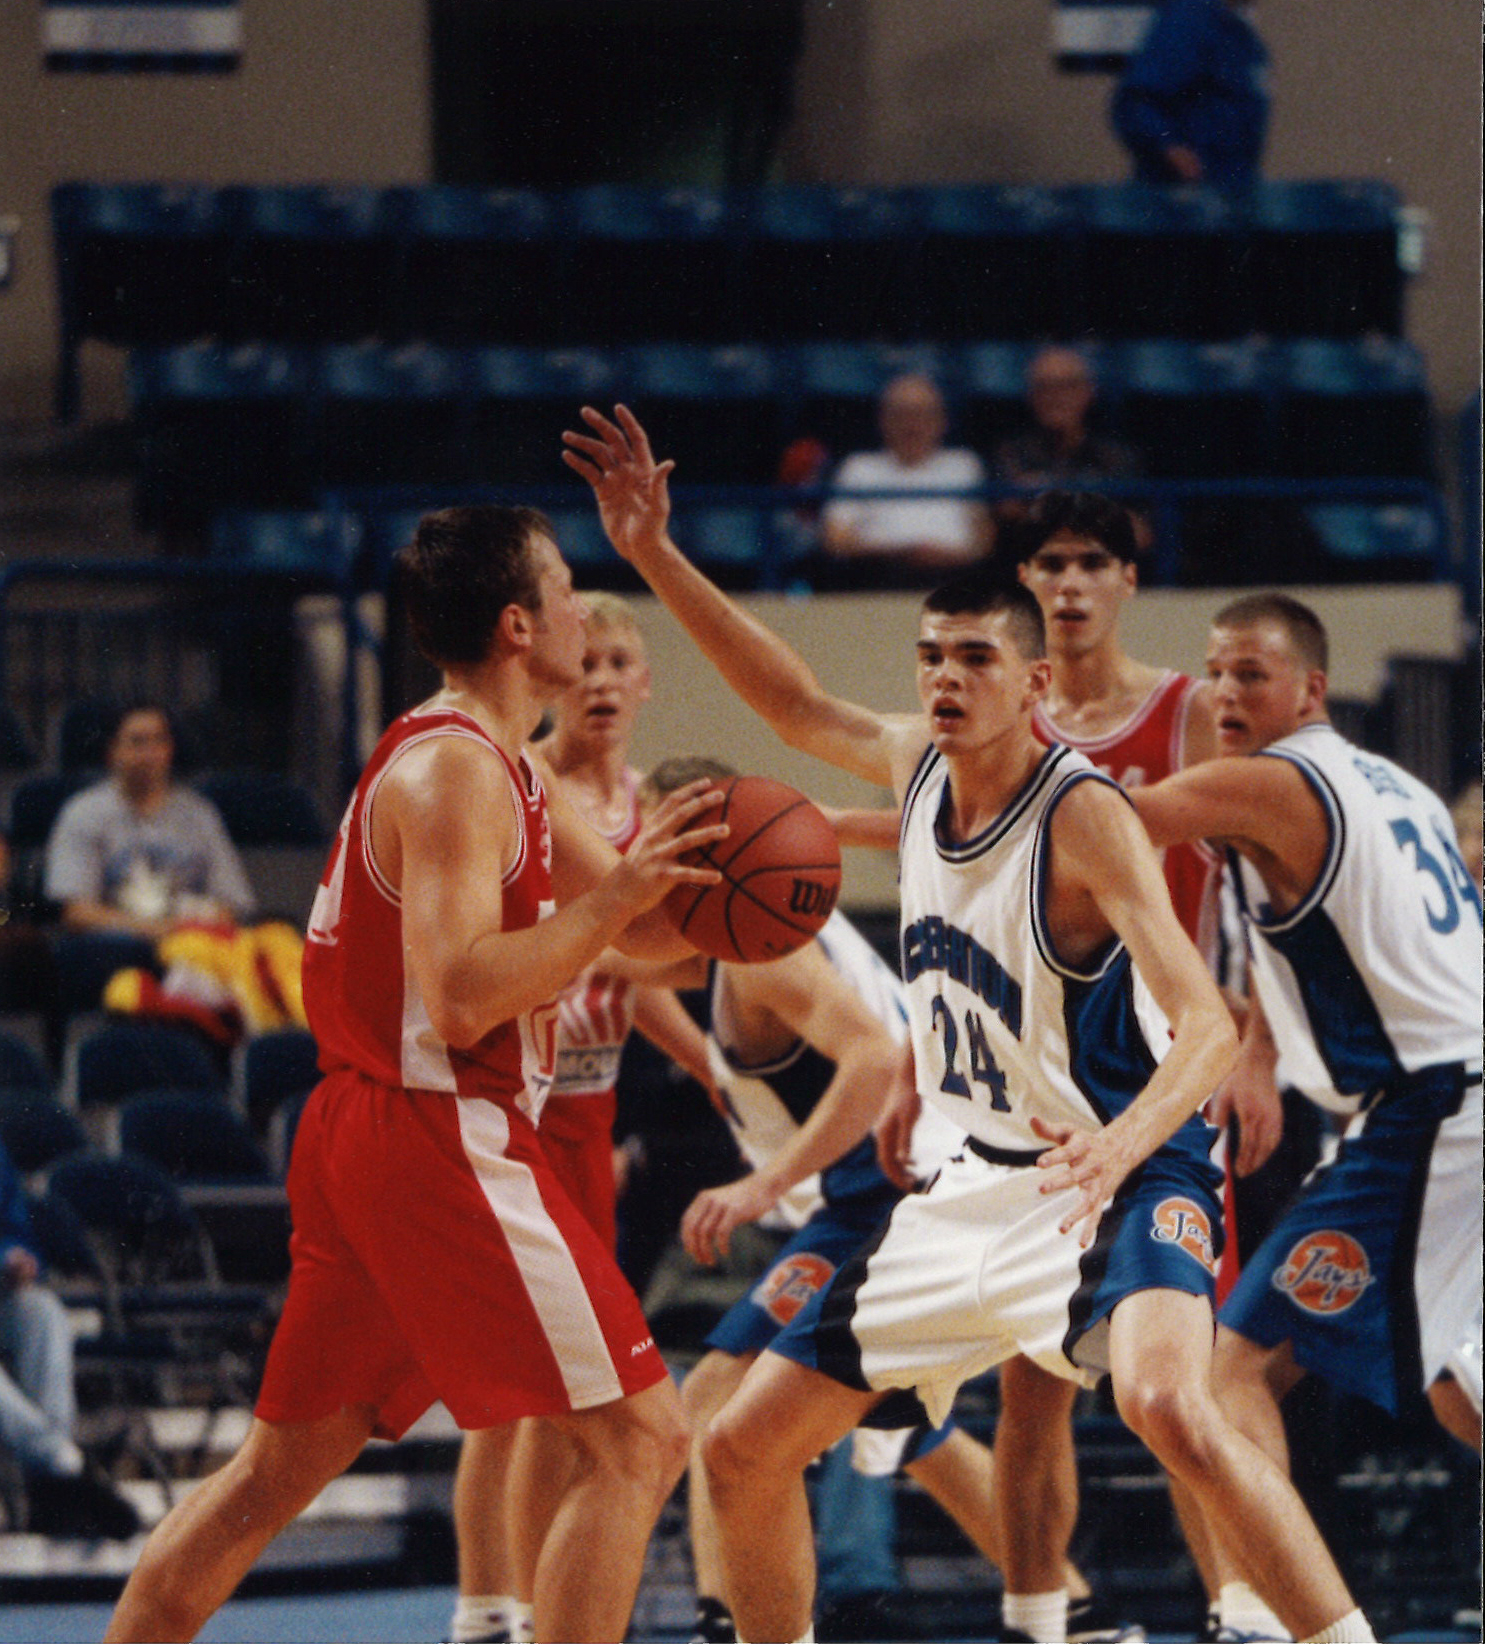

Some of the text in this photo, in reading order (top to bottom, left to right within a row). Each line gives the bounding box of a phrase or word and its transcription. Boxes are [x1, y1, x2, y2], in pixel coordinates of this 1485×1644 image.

[1387, 816, 1483, 936] 34
[931, 994, 1012, 1113] 24
[1271, 1246, 1377, 1304] Jays
